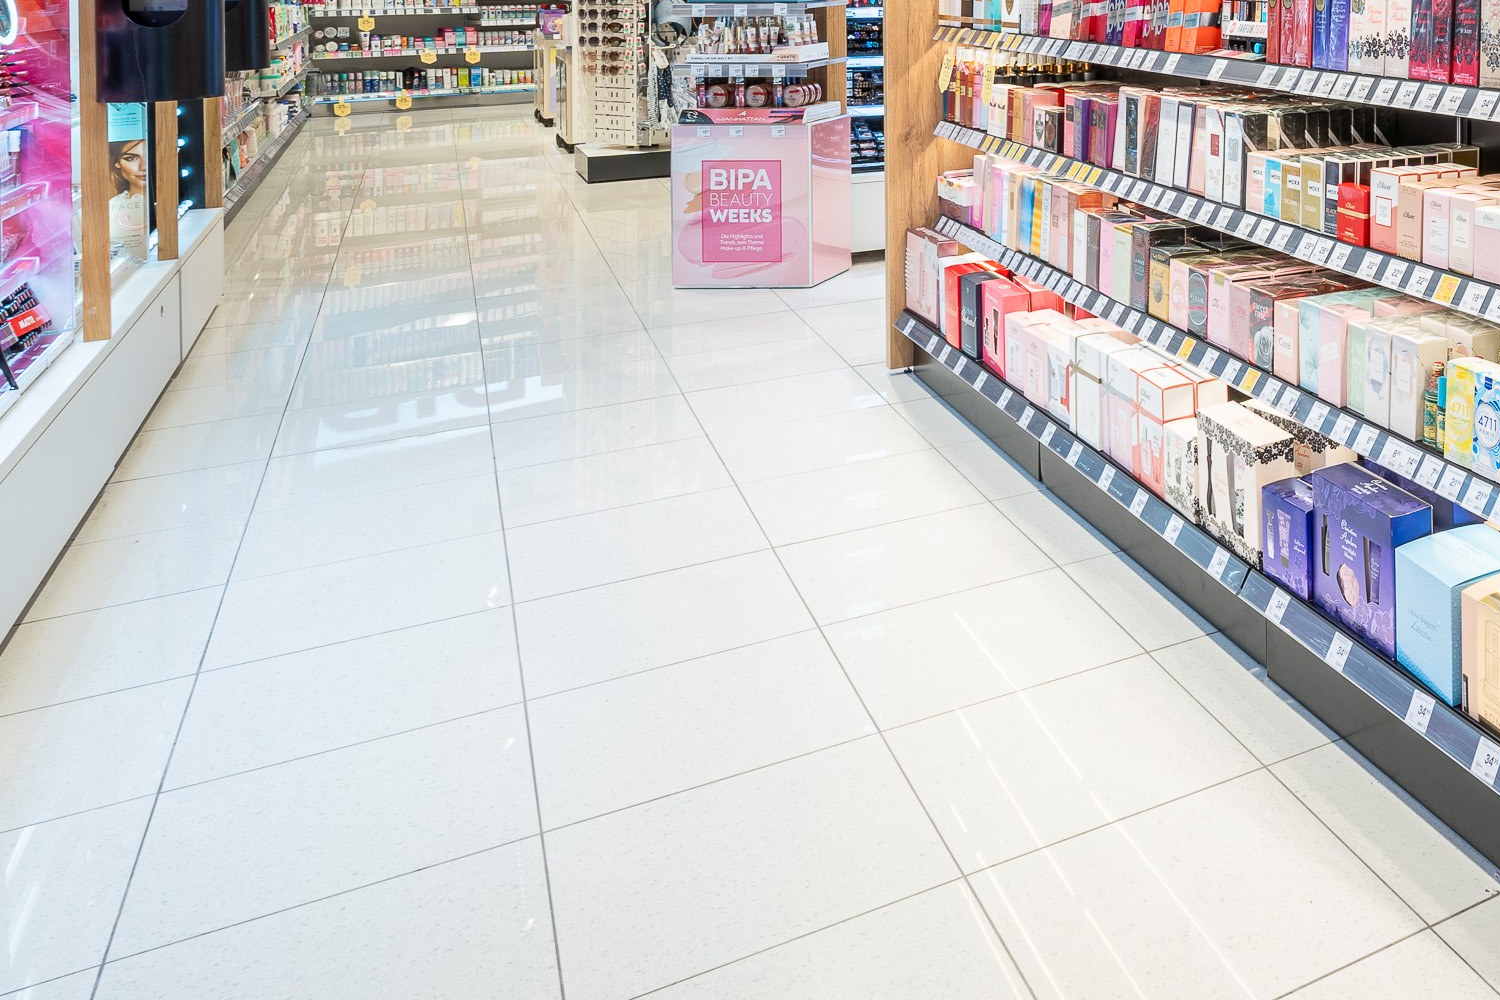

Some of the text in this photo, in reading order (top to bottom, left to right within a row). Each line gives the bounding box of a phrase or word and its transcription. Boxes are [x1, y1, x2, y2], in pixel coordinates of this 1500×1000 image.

[710, 169, 772, 190] BIPA
[112, 202, 141, 210] FACE
[710, 193, 772, 206] BEAUTY
[709, 209, 772, 223] WEEKS
[1253, 303, 1268, 311] sweet
[18, 316, 35, 329] MATTE
[1450, 401, 1470, 419] 4711
[1477, 415, 1497, 430] 4711
